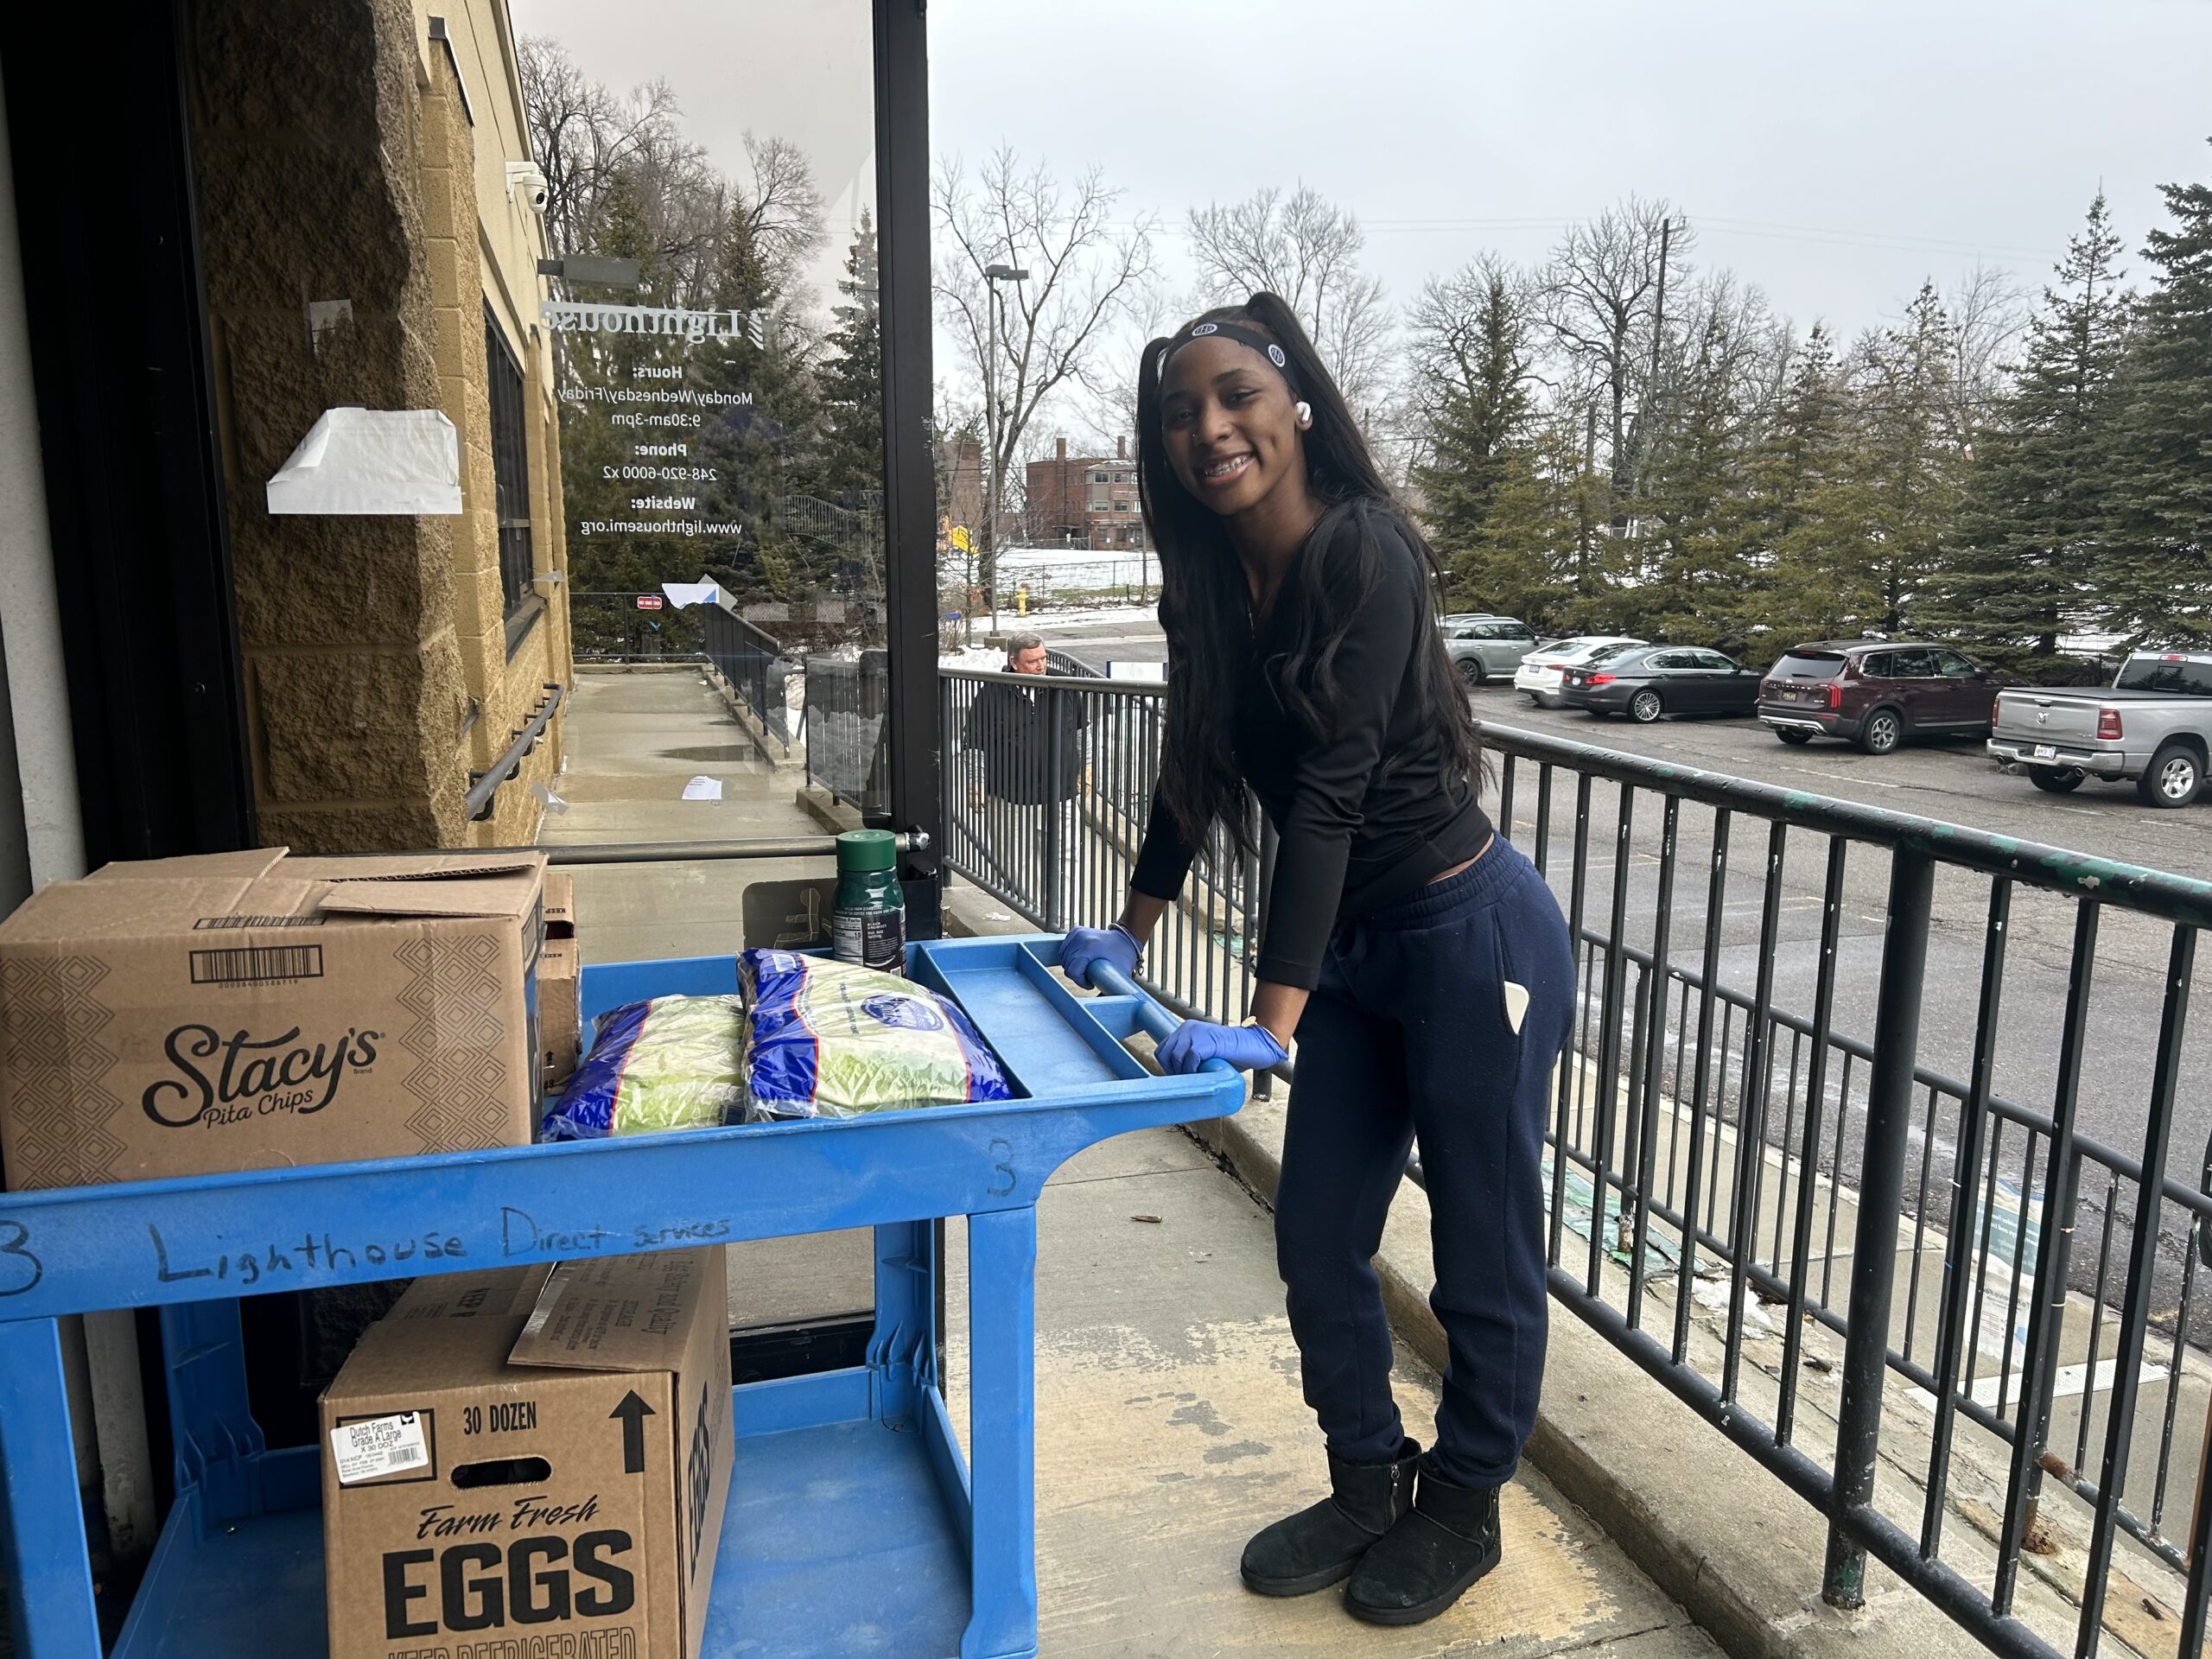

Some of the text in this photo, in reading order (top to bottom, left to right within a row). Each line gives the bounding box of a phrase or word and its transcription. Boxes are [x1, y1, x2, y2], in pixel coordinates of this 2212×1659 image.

[142, 1024, 379, 1128] Stacy's
[203, 1090, 313, 1129] Pita Chips
[147, 1223, 468, 1287] Lighthouse
[500, 1206, 607, 1258] Direct
[456, 1288, 492, 1308] KEEP
[640, 1307, 681, 1335] Quality
[349, 1421, 394, 1439] Dutch Farms
[462, 1401, 537, 1435] 30 DOZEN
[351, 1429, 402, 1447] Grade A Large
[416, 1494, 600, 1540] Farm Fresh
[382, 1529, 636, 1640] EGGS
